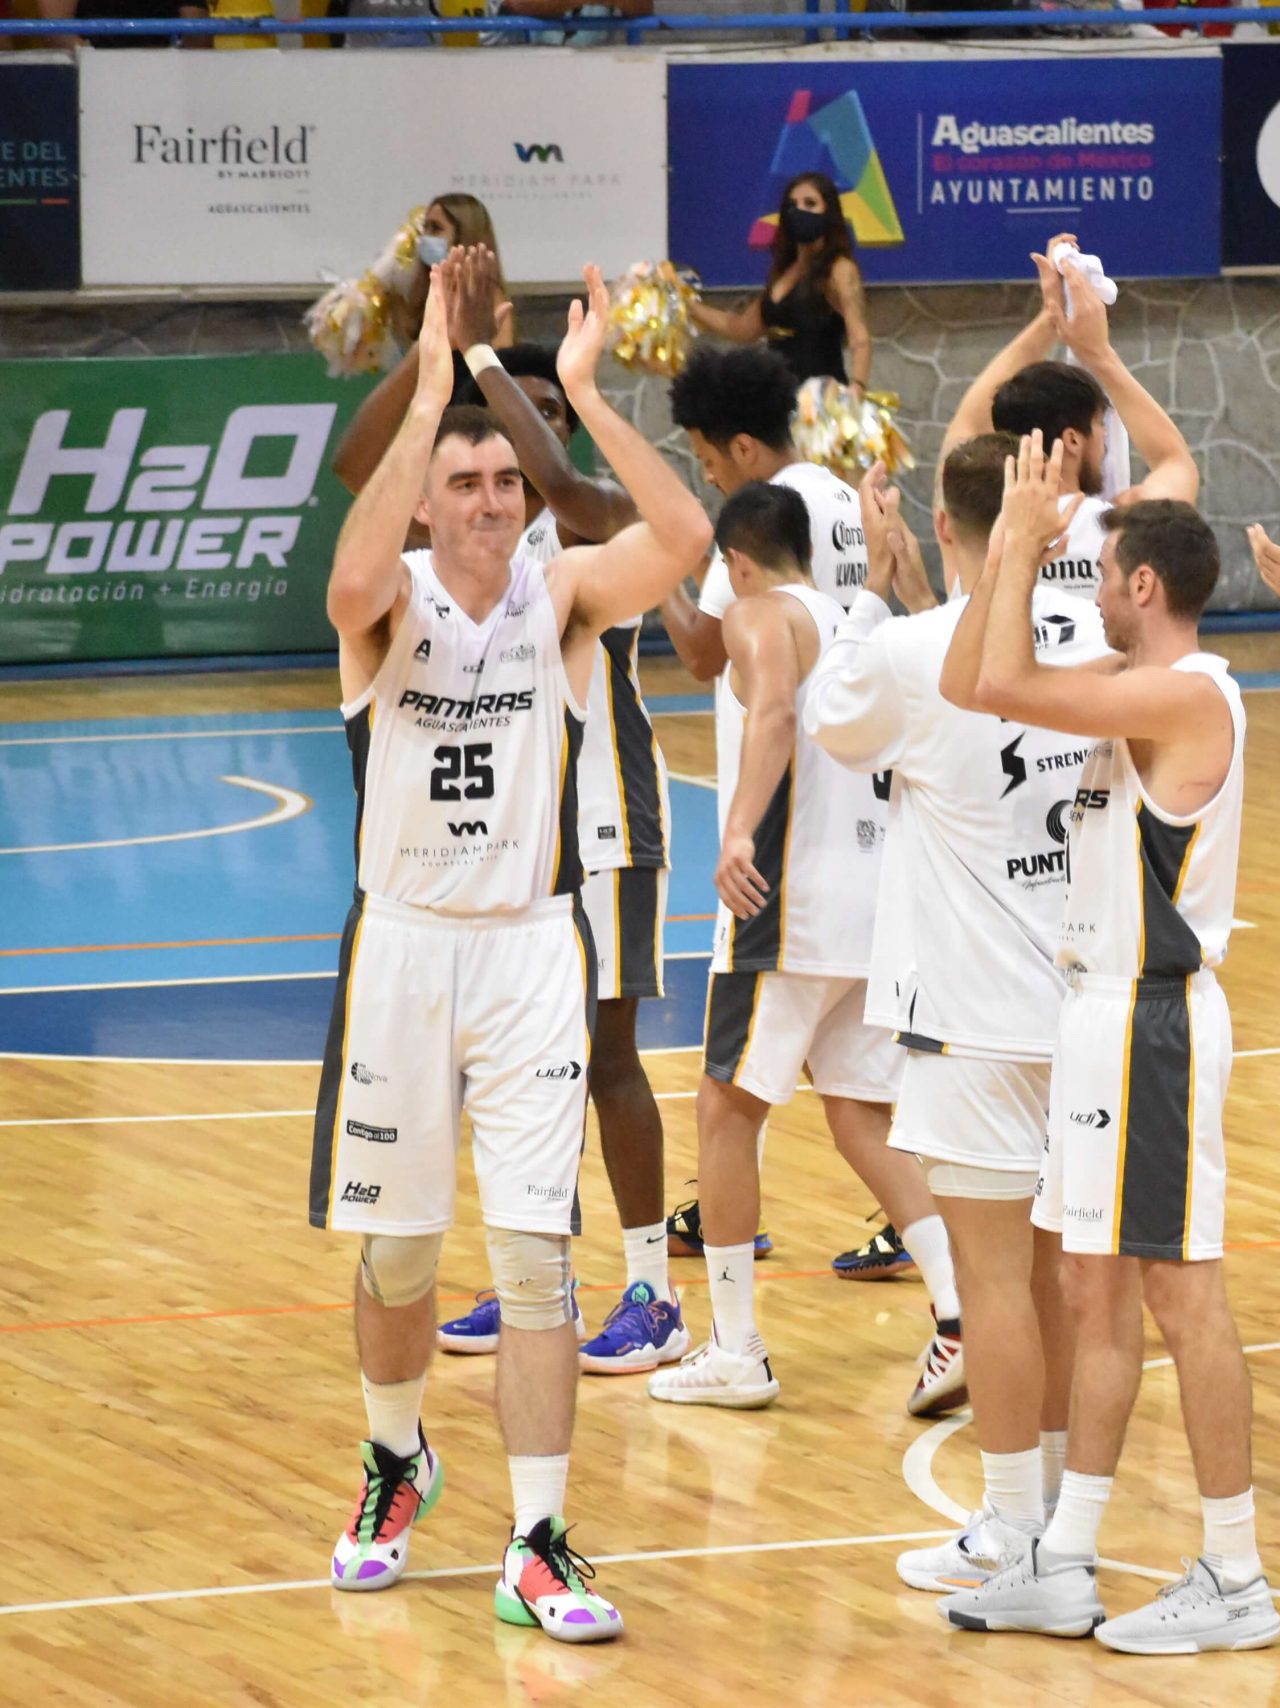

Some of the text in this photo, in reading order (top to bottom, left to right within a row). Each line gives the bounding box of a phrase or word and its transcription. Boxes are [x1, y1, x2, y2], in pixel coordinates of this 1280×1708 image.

[133, 124, 309, 164] Fairfield
[932, 115, 1155, 153] Aguascalientes
[23, 142, 66, 160] DEL
[931, 176, 1154, 204] AYUNTAMIENTO
[7, 403, 338, 515] H2O
[0, 516, 302, 574] POWER
[398, 690, 533, 719] PANTRAS
[414, 716, 511, 733] AGUASCAIENTES
[430, 742, 494, 801] 25
[400, 845, 482, 858] MERIDIAM
[536, 1065, 570, 1079] udi
[1069, 1110, 1097, 1127] udi
